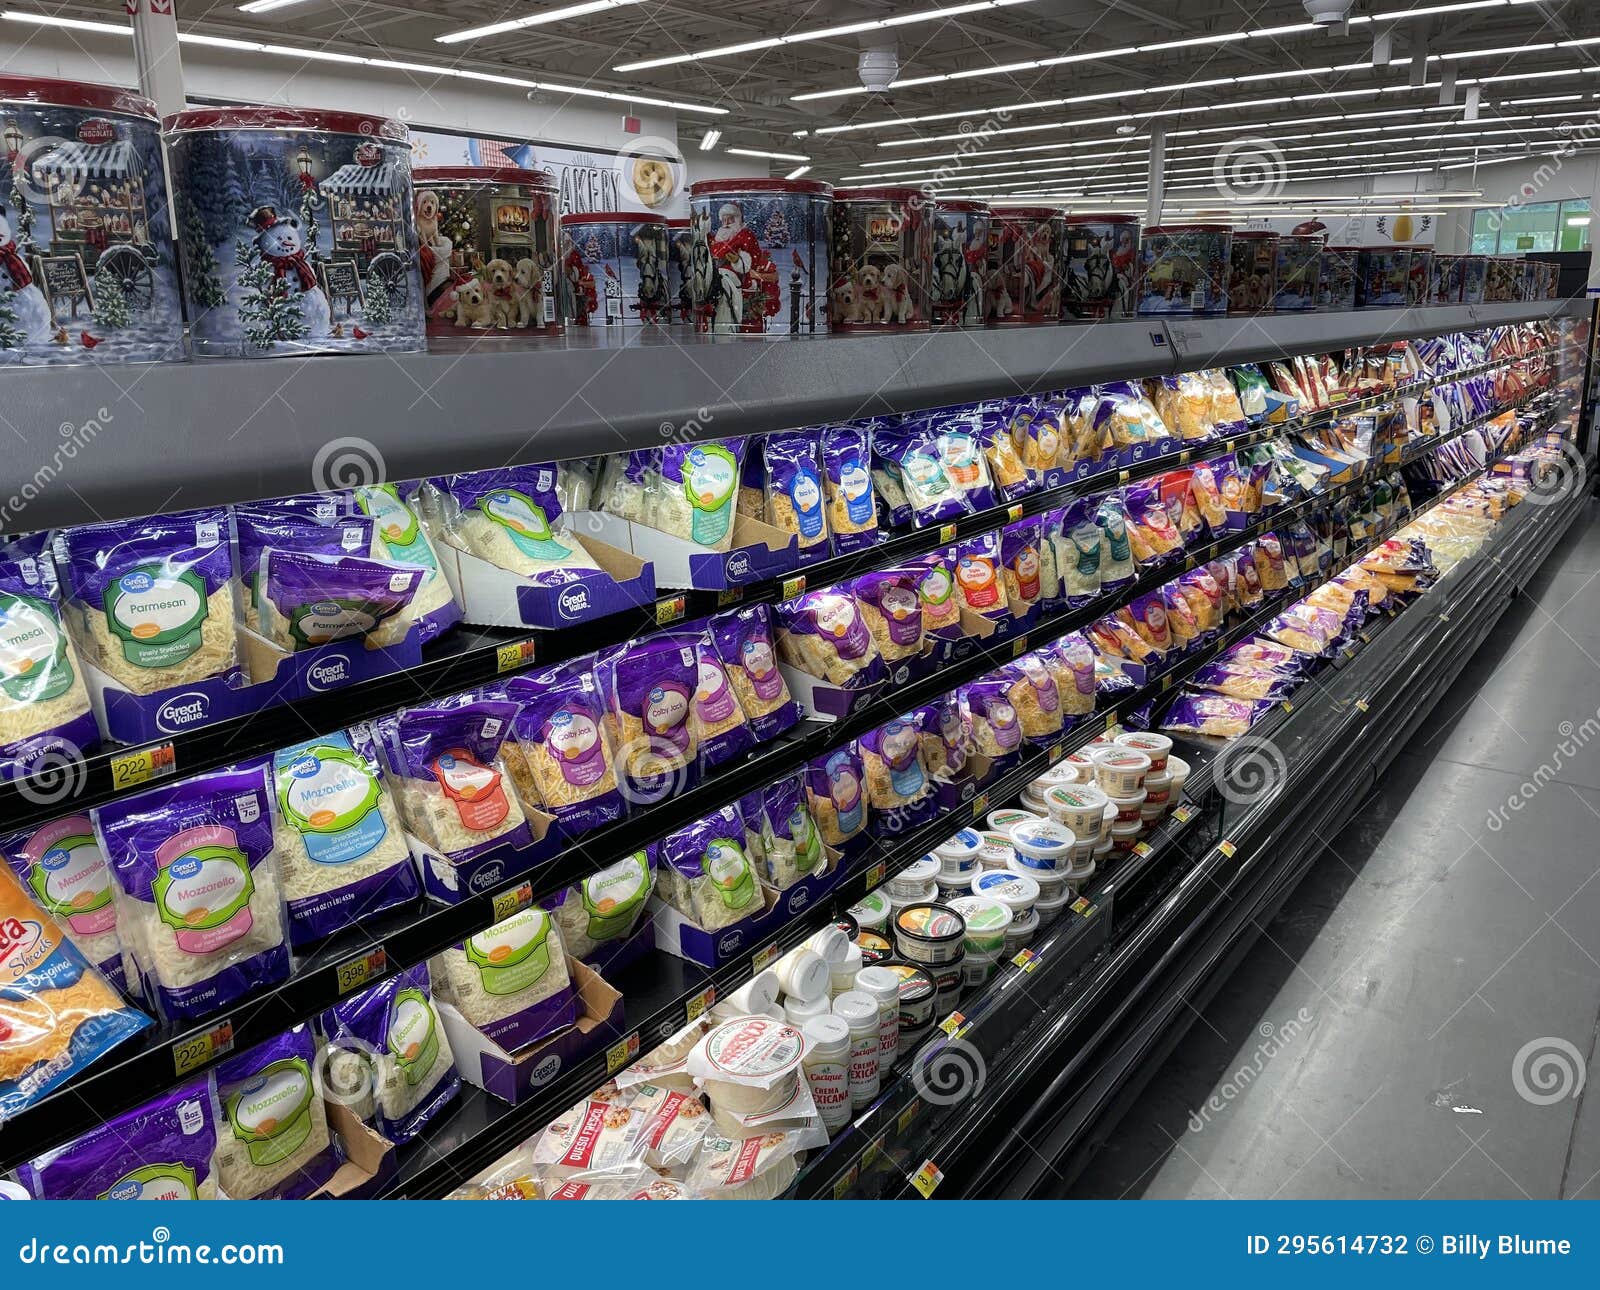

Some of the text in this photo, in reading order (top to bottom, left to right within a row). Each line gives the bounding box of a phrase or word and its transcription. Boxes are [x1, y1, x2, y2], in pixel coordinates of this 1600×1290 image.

[201, 529, 216, 538] 6oz
[730, 558, 748, 570] Great
[124, 576, 151, 587] Great
[562, 591, 586, 606] Great
[130, 598, 186, 614] Parmesan
[569, 602, 587, 612] Value
[159, 643, 190, 654] Shredded
[501, 650, 518, 667] 222
[313, 663, 344, 677] Great
[321, 672, 344, 684] Value
[164, 700, 203, 720] Great
[173, 712, 203, 725] Value
[578, 726, 591, 736] Jack
[118, 758, 147, 782] 222
[301, 778, 356, 801] Mozzarella
[243, 810, 256, 818] 7oz
[172, 862, 196, 872] Great
[474, 865, 501, 883] Great
[481, 876, 500, 888] Value
[595, 870, 635, 890] Mozzarella
[178, 875, 236, 901] Mozzarella
[304, 906, 312, 916] WT
[483, 913, 534, 940] Mozzarella
[721, 935, 739, 949] Great
[9, 939, 53, 977] Shreds
[342, 965, 365, 987] 398
[180, 1041, 206, 1067] 222
[533, 1060, 556, 1078] Great
[853, 1060, 874, 1069] CREMA
[247, 1084, 298, 1115] Mozzarella
[813, 1090, 848, 1104] EXICANA
[660, 1097, 680, 1117] RESCO
[184, 1111, 198, 1120] 8oz
[570, 1136, 588, 1160] QUESO
[586, 1108, 604, 1135] FRESCO
[111, 1185, 136, 1198] Great
